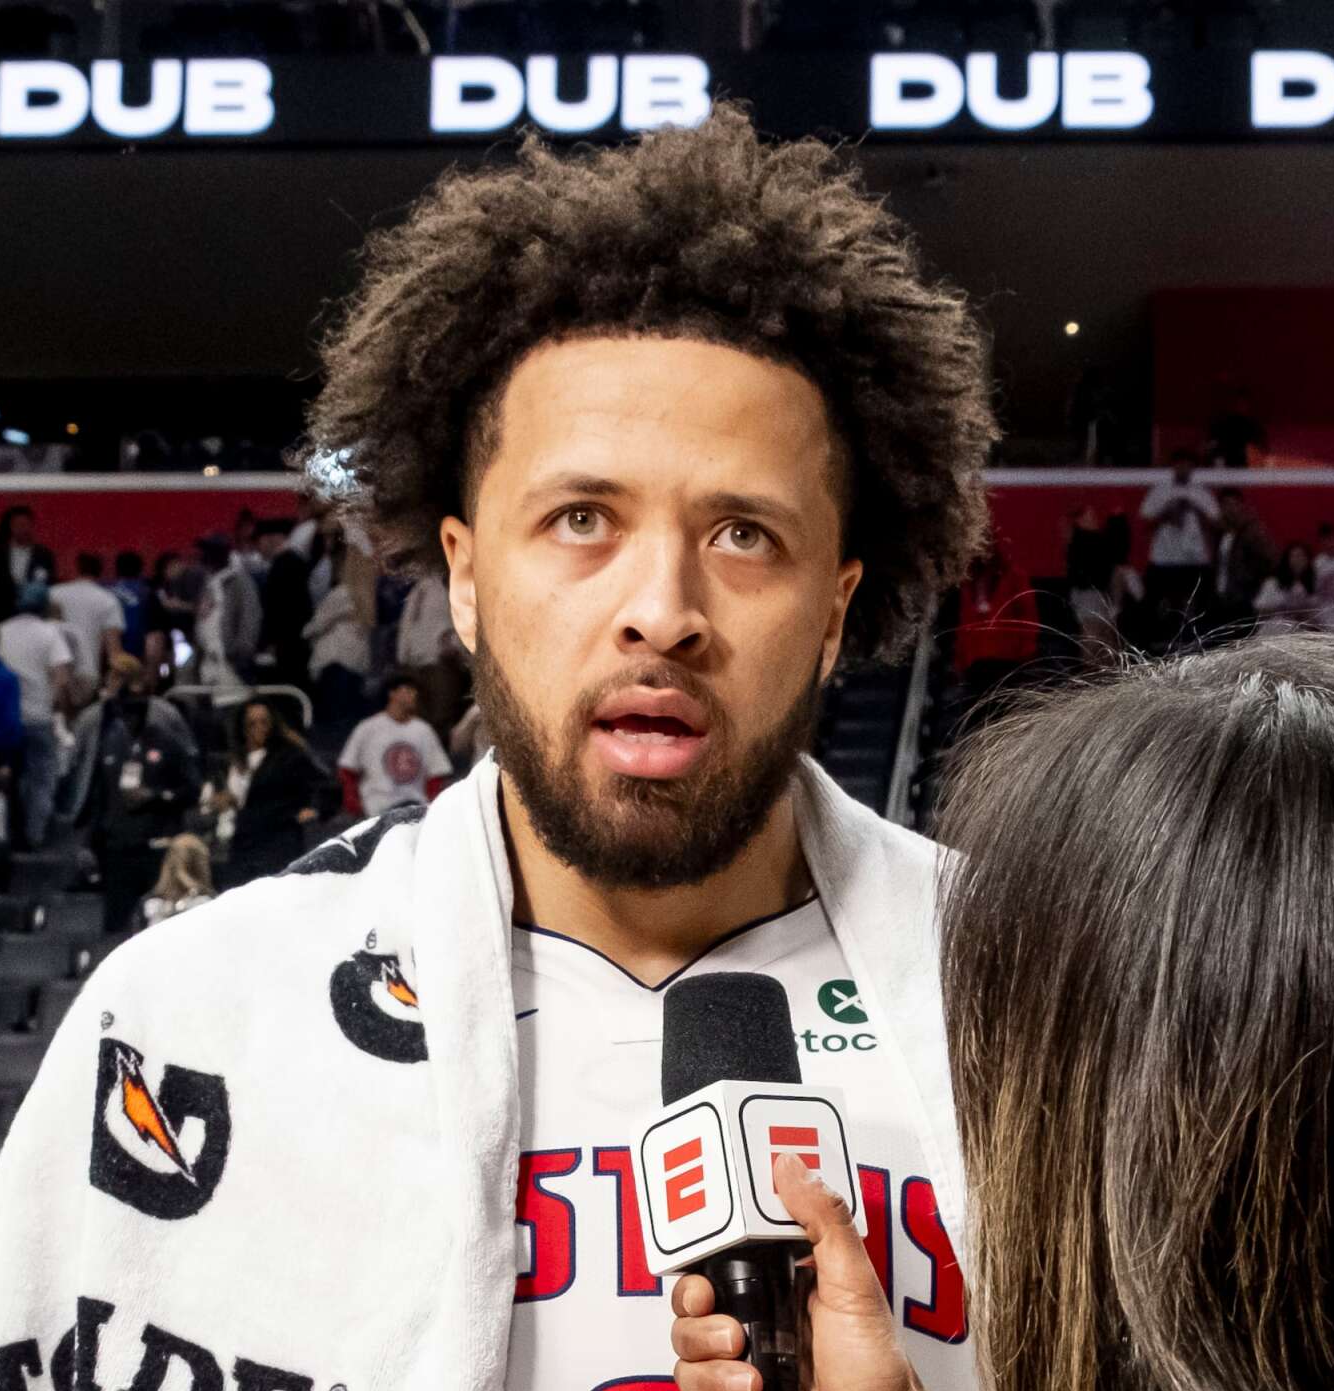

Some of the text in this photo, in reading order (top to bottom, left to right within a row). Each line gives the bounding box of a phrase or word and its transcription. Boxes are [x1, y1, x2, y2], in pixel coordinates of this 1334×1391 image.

[430, 54, 711, 131] DUB
[870, 51, 1154, 130] DUB
[794, 1029, 878, 1053] toc
